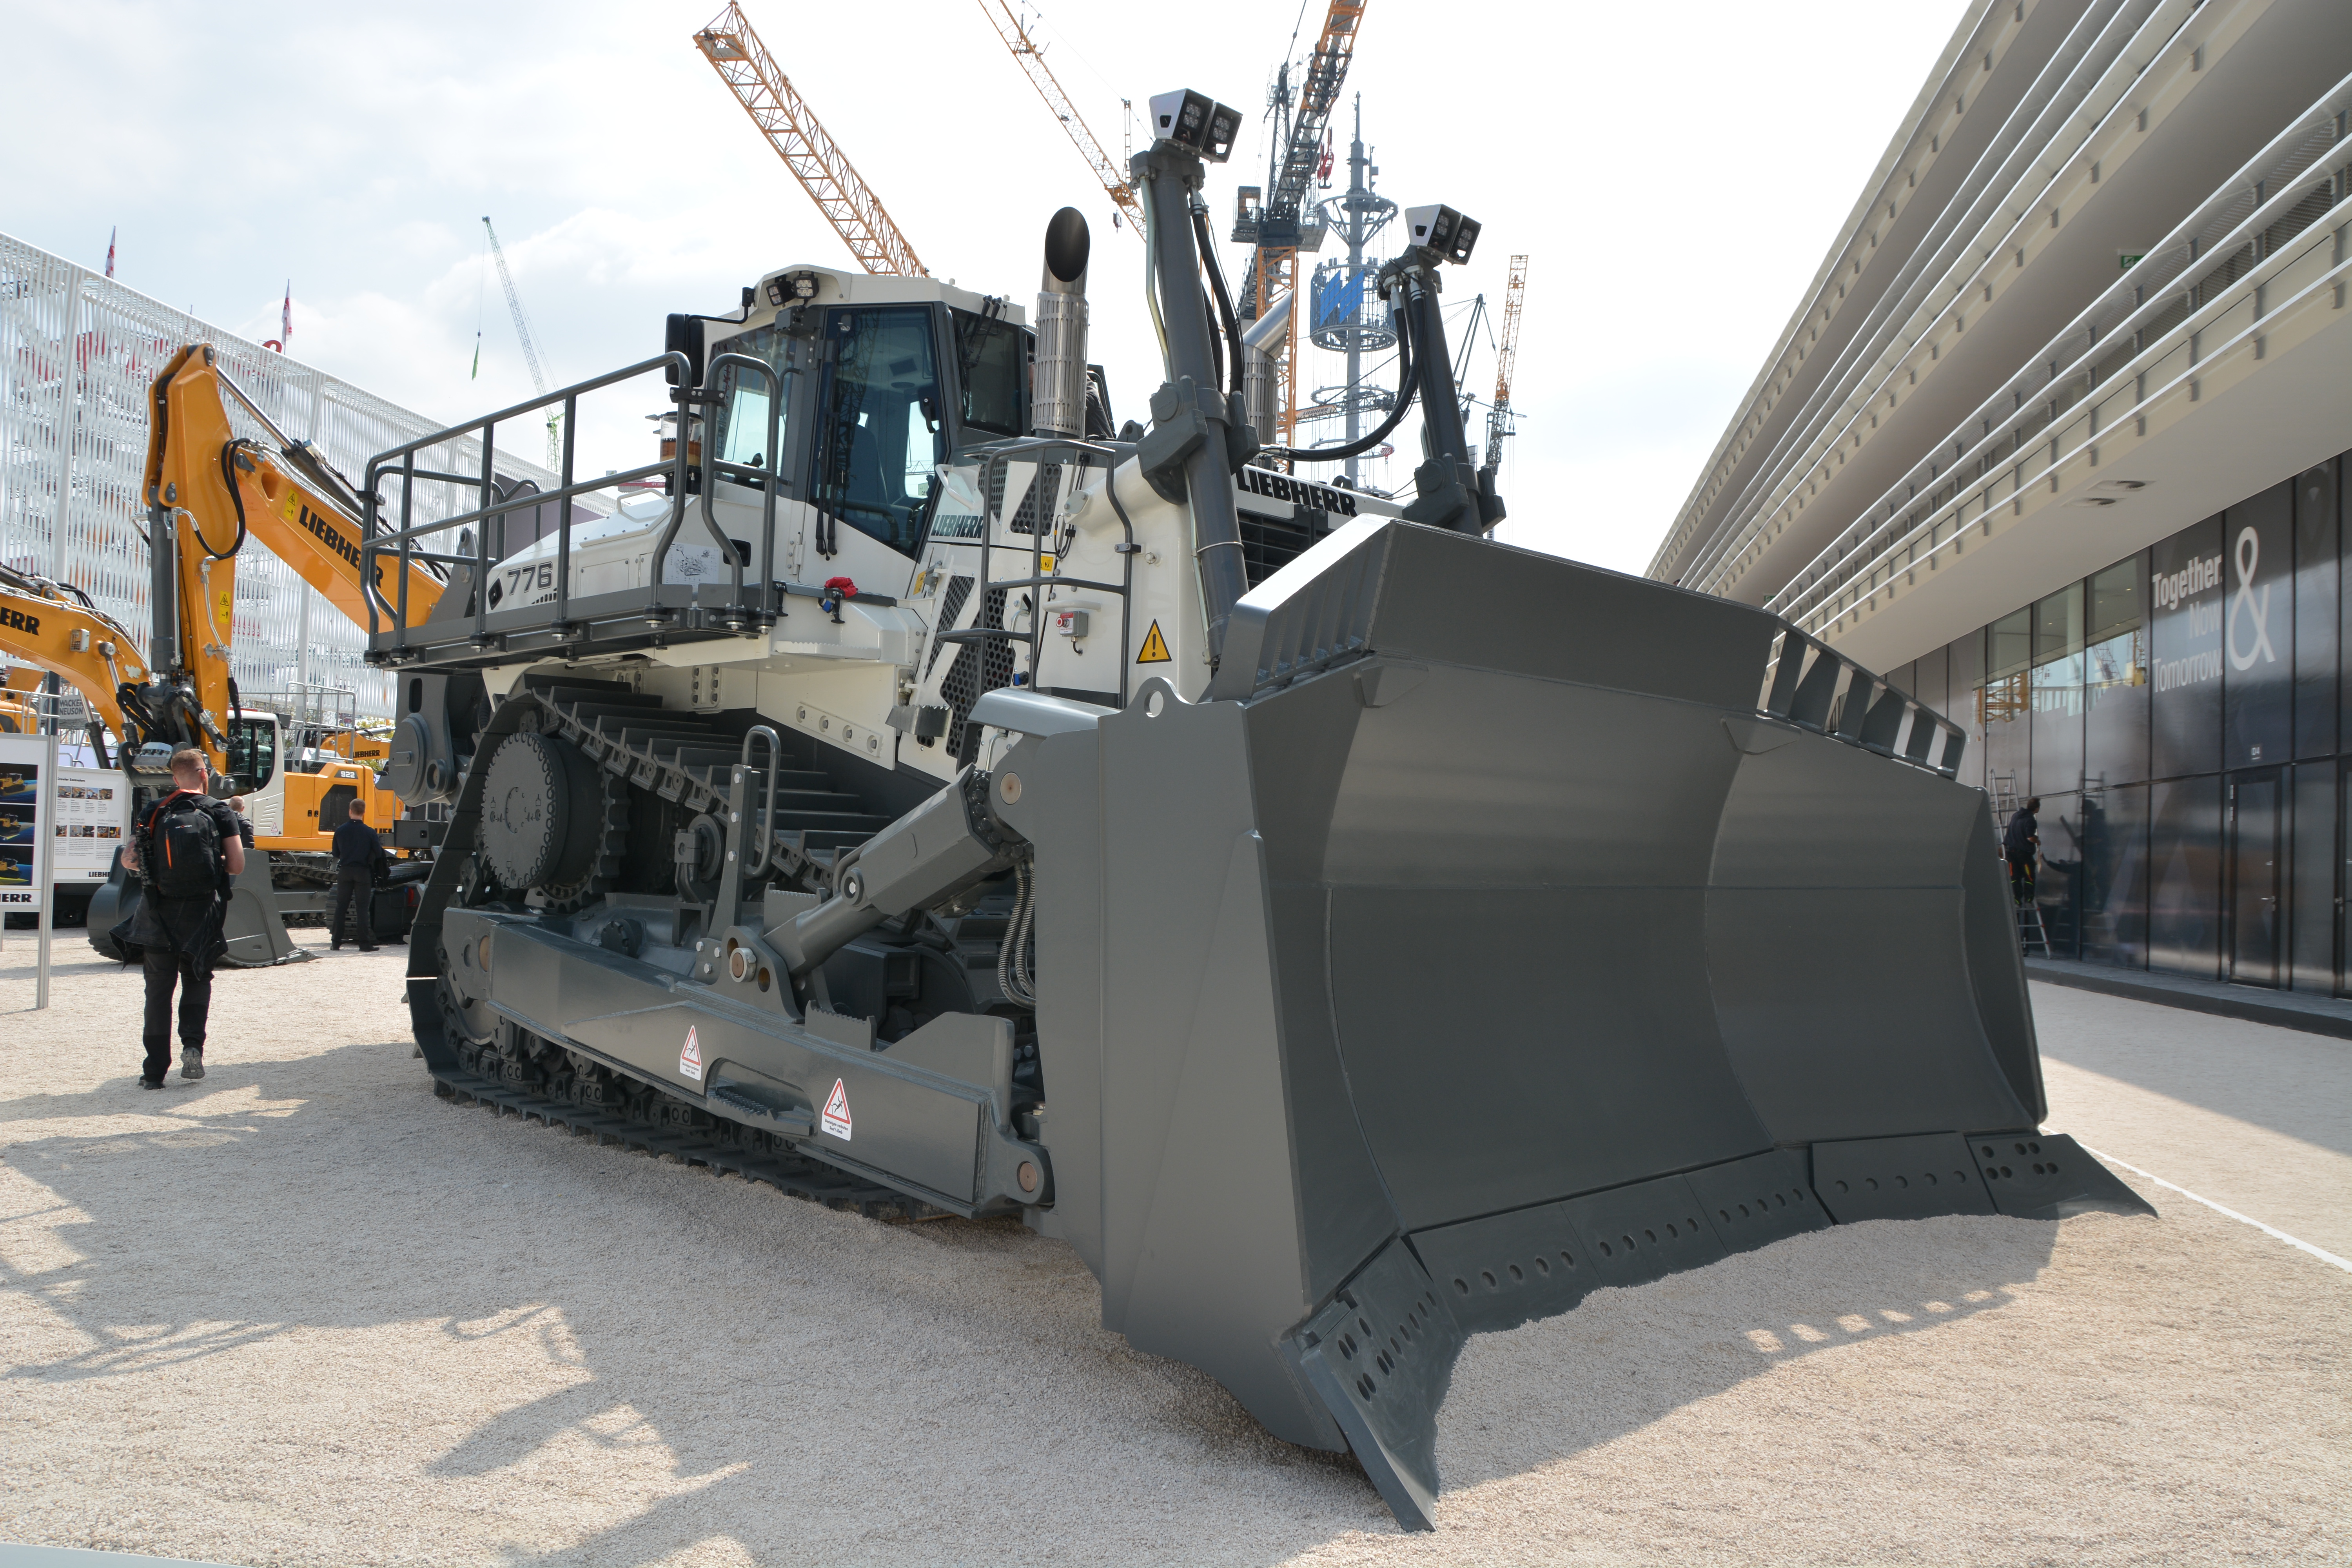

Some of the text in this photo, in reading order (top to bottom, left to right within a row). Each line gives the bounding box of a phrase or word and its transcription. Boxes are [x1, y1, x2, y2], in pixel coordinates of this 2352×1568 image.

[1303, 407, 1329, 416] LIEBHERR
[1236, 468, 1358, 517] LIEBHERR
[299, 504, 383, 589] LIEBHER
[931, 515, 984, 539] LIEBHERR
[507, 561, 553, 596] 776
[2152, 554, 2222, 610] Together.
[2228, 526, 2276, 671] &
[2189, 601, 2222, 639] Now
[2152, 648, 2223, 693] Tomorrow.
[0, 893, 32, 902] ERR
